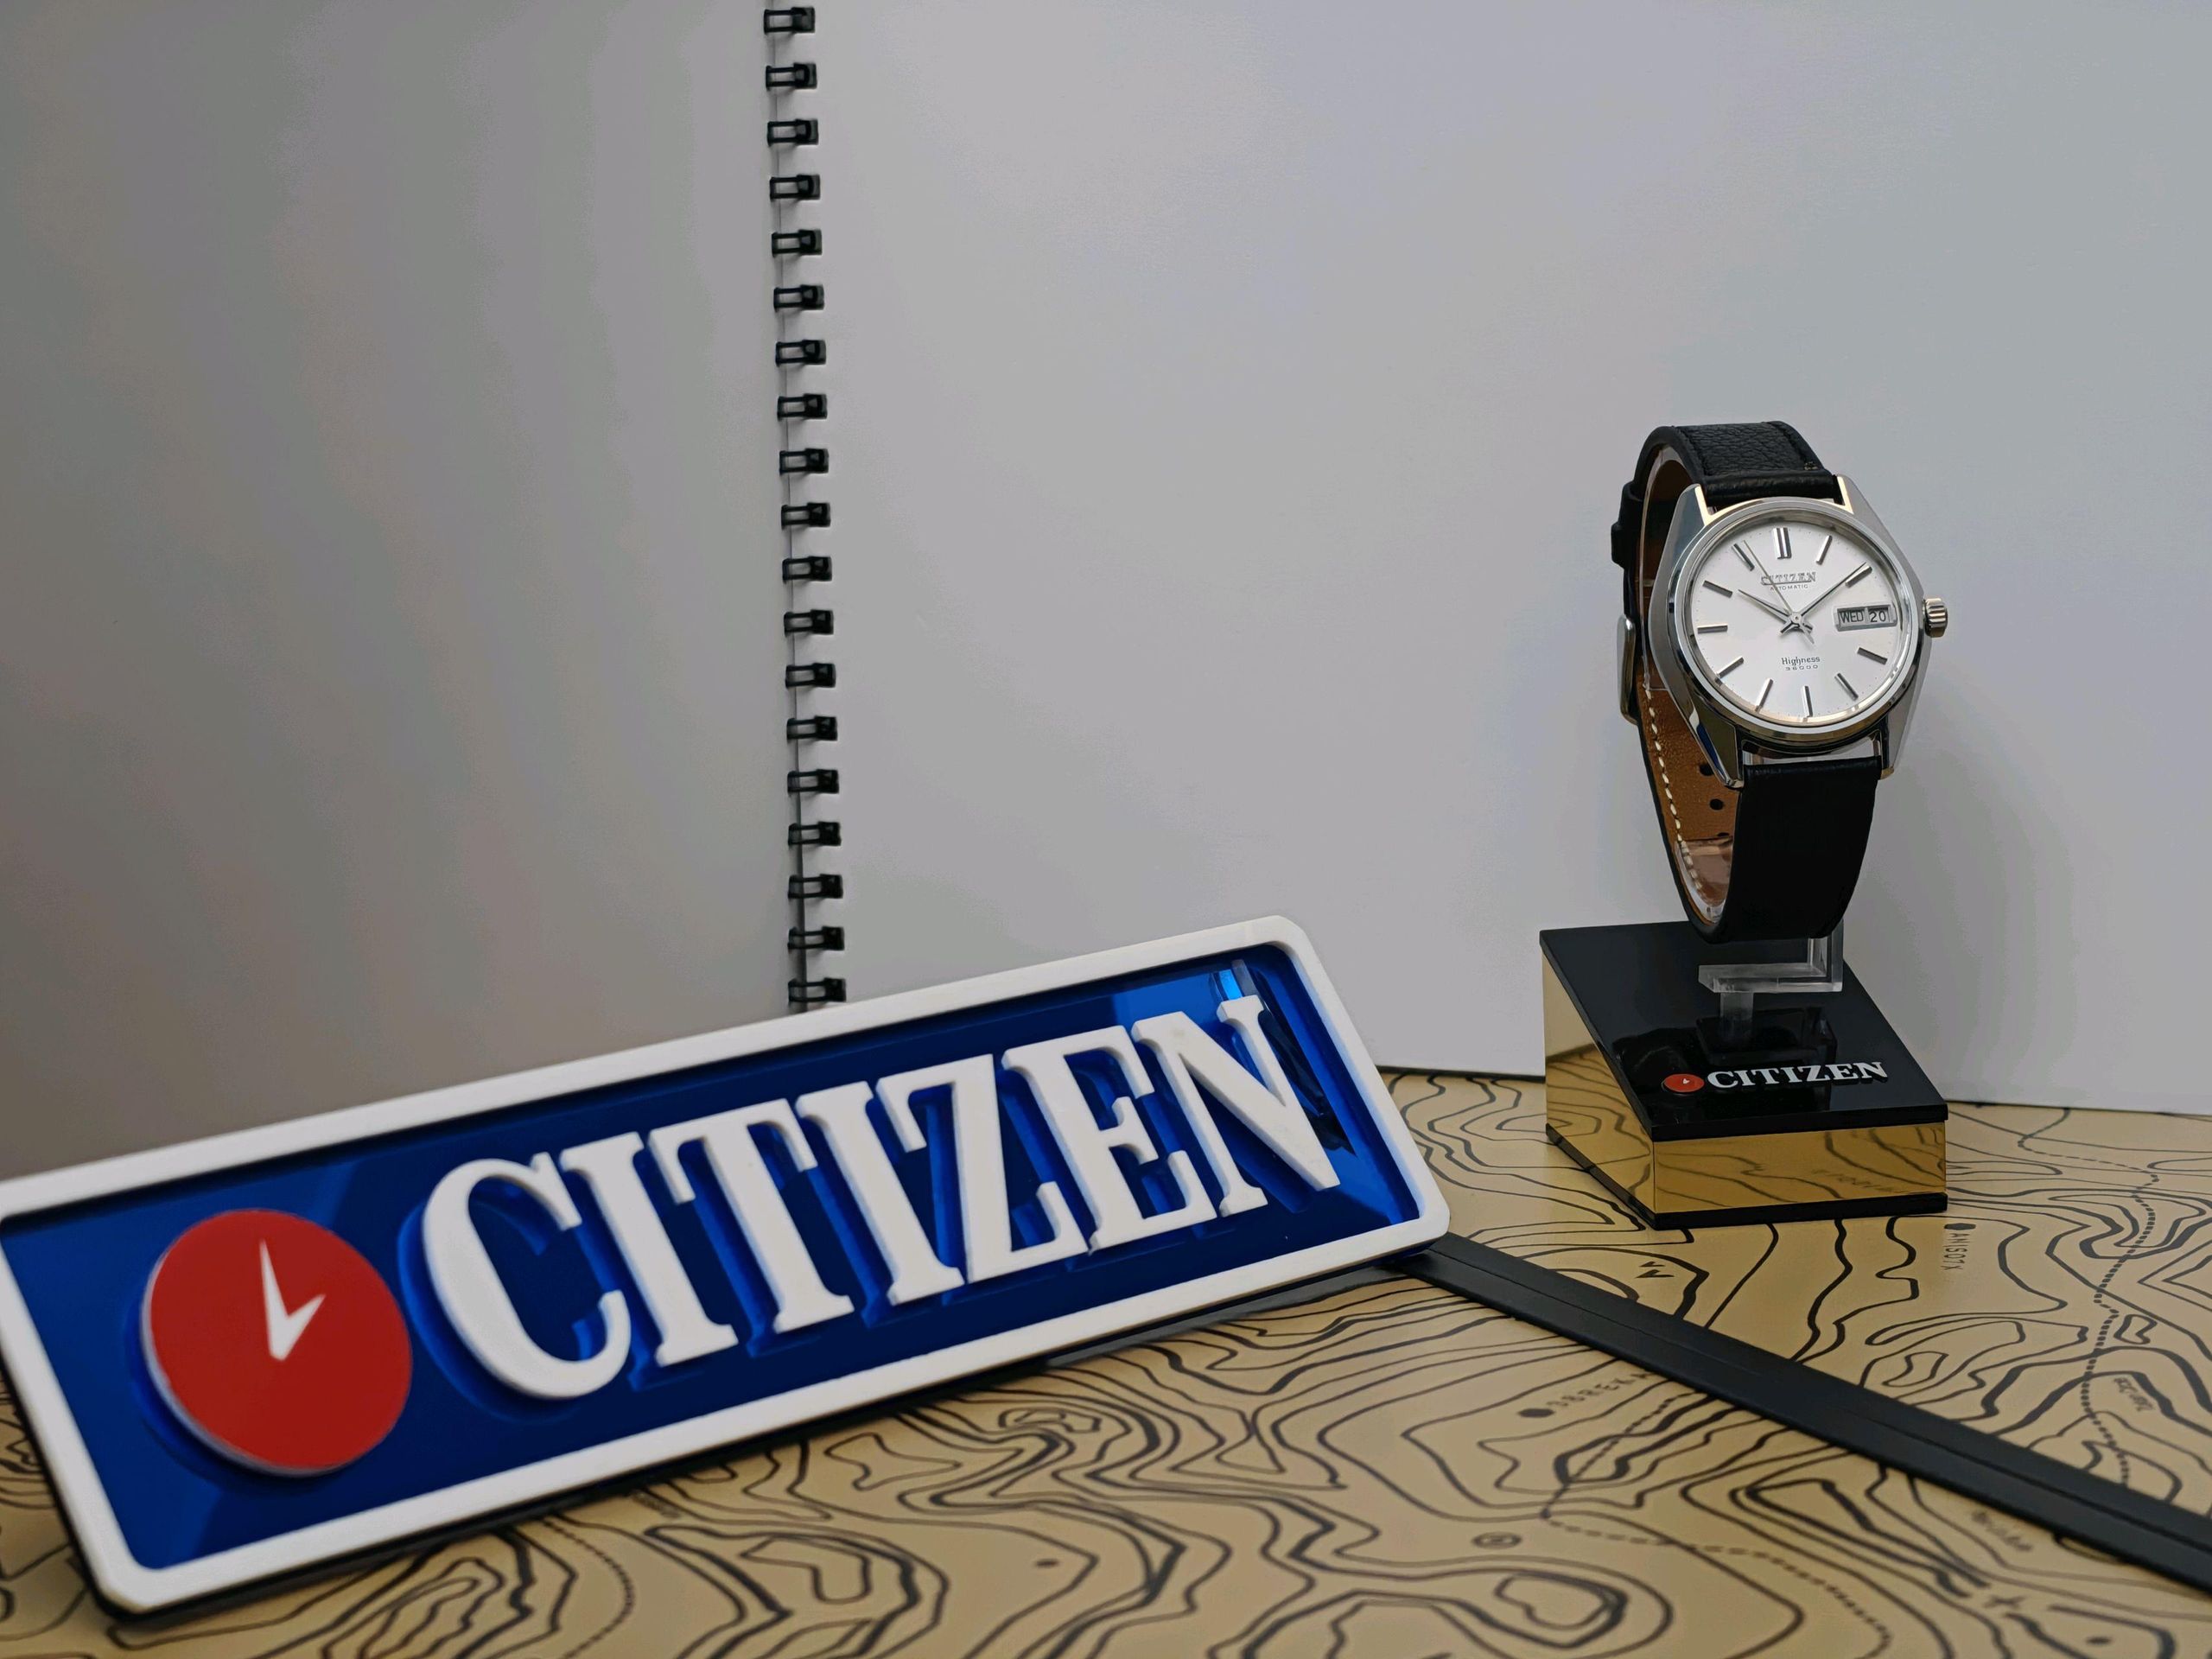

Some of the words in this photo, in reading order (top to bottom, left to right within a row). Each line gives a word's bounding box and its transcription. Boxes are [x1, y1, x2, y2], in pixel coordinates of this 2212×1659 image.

[1761, 571, 1816, 586] CITIZEN
[1840, 610, 1865, 624] WED
[1870, 610, 1887, 623] 20
[1781, 657, 1821, 666] Highness
[1707, 1061, 1888, 1089] CITIZEN
[422, 995, 1341, 1399] CITIZEN
